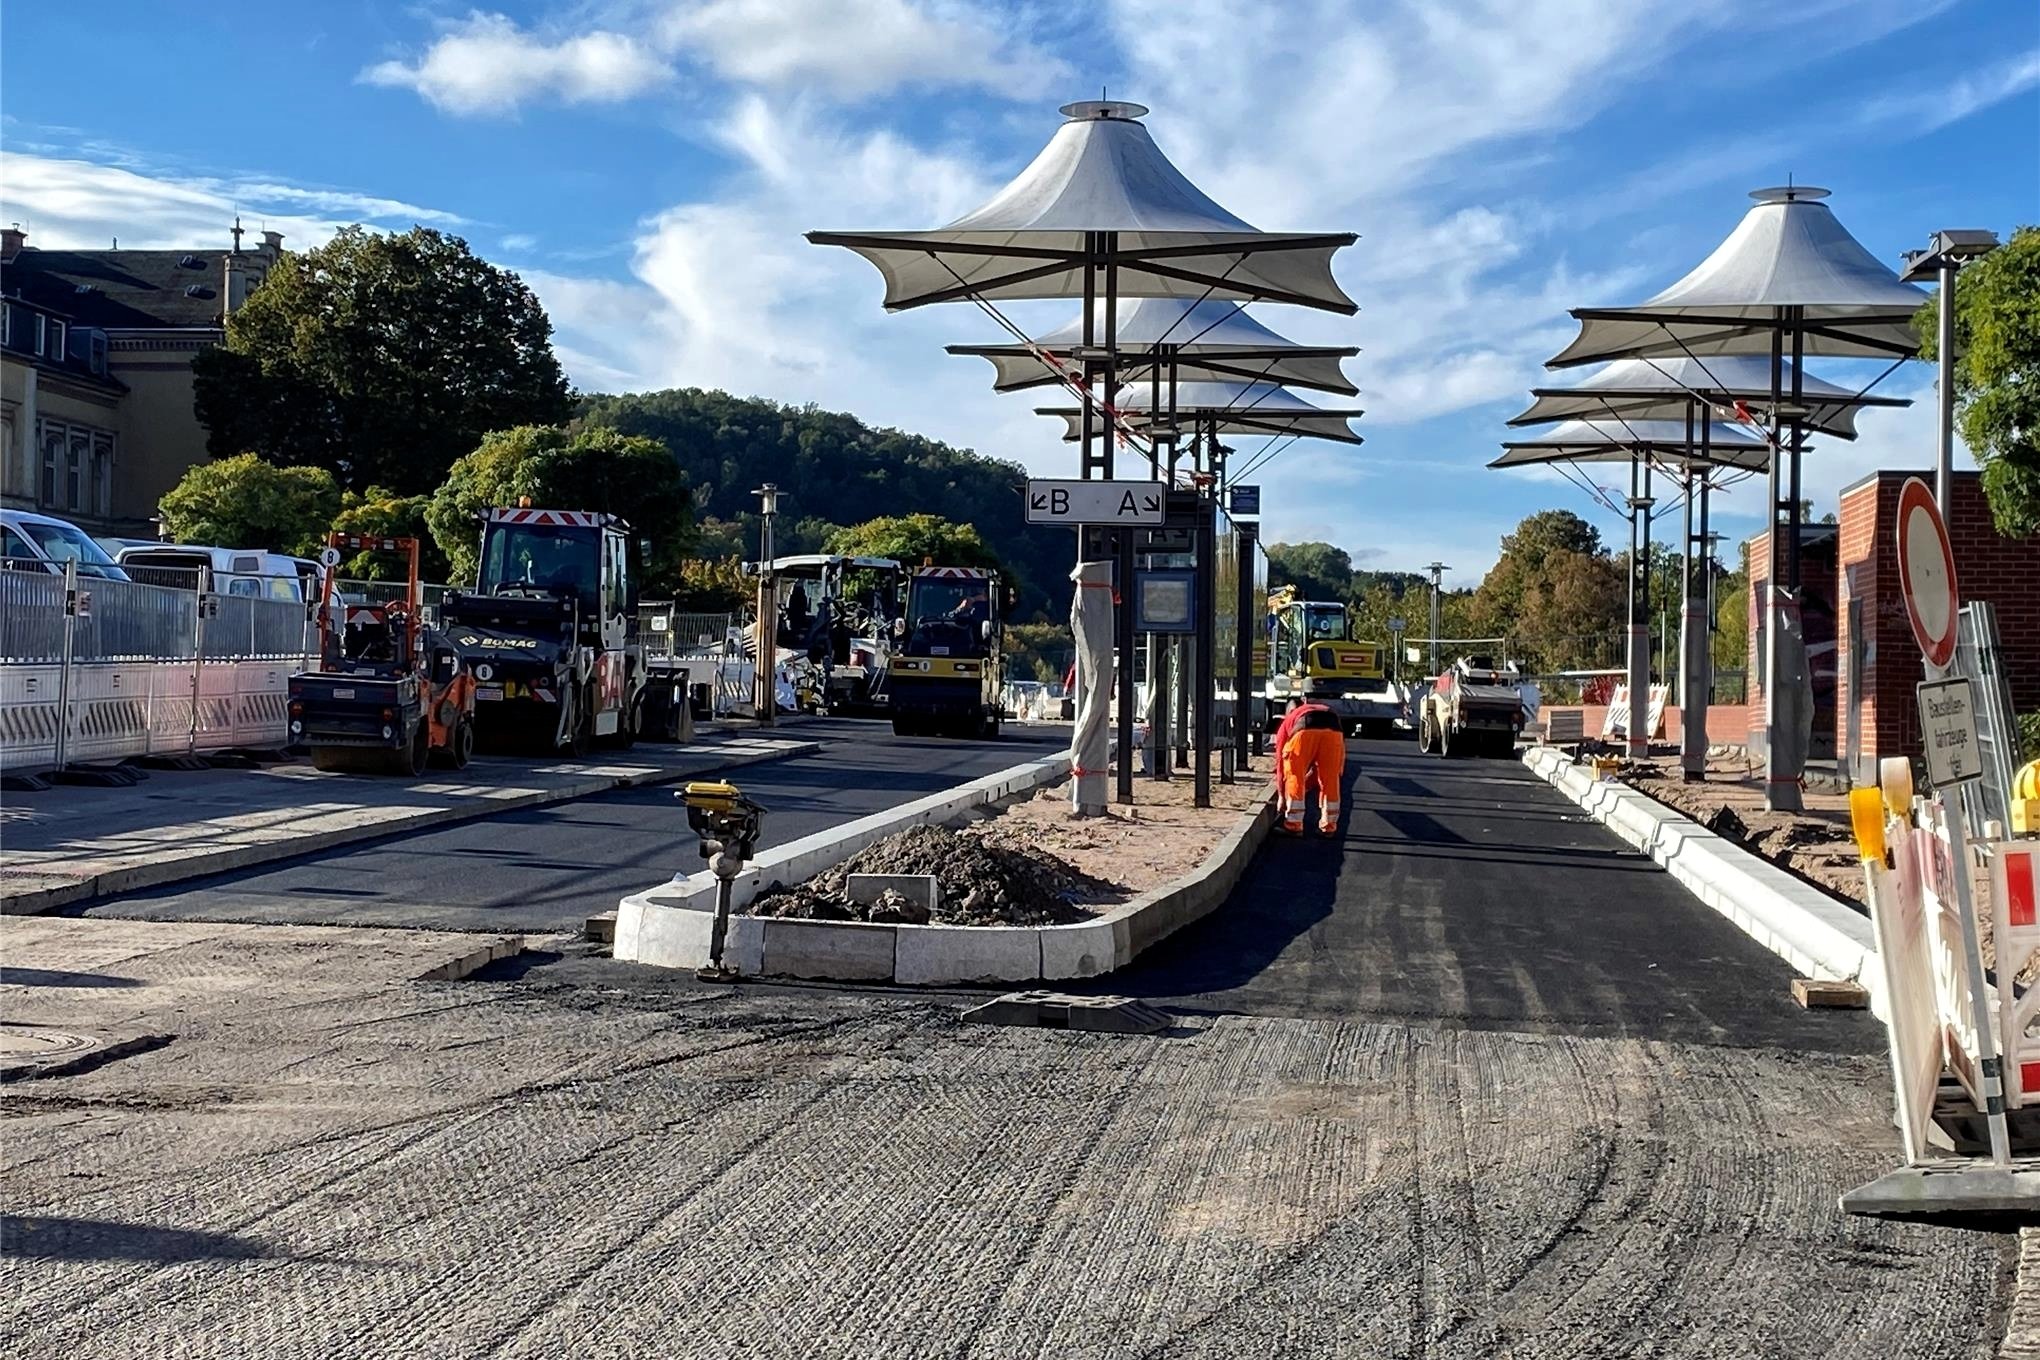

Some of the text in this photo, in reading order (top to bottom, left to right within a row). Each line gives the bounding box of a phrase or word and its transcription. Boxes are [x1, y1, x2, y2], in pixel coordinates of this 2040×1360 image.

[1051, 489, 1139, 516] B A
[482, 638, 537, 648] BOMAG
